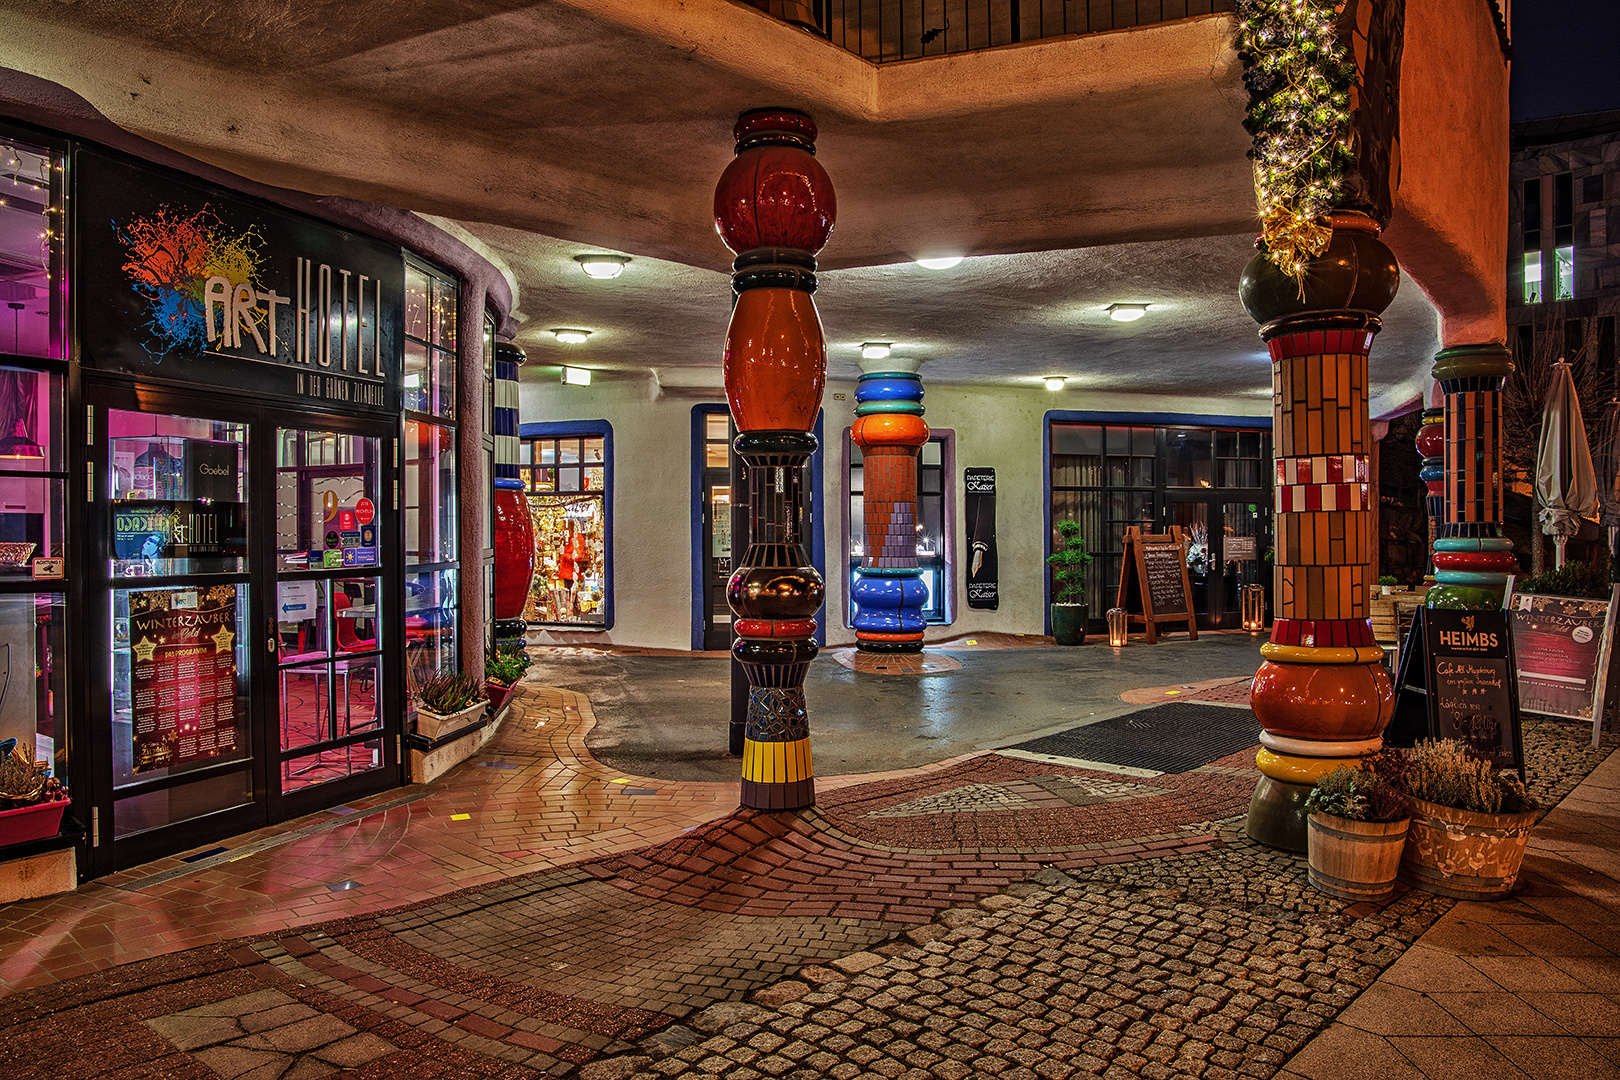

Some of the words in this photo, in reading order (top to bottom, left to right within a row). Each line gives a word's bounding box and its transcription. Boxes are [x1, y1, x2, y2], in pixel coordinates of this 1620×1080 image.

[204, 276, 291, 358] ART
[296, 256, 386, 378] HOTEL
[296, 372, 304, 395] IN
[309, 374, 321, 397] DER
[199, 462, 230, 476] Goebel
[966, 481, 995, 491] Kaiser
[322, 490, 339, 523] 9
[188, 513, 219, 544] HOTEL
[968, 589, 997, 599] Kaiser
[136, 612, 230, 631] WINTERZAUBER
[1515, 612, 1600, 628] WINTERZAUBER
[180, 627, 202, 644] Gold
[1439, 630, 1499, 648] HEIMBS
[175, 647, 208, 657] PROGRAMM
[1440, 697, 1467, 715] täglich
